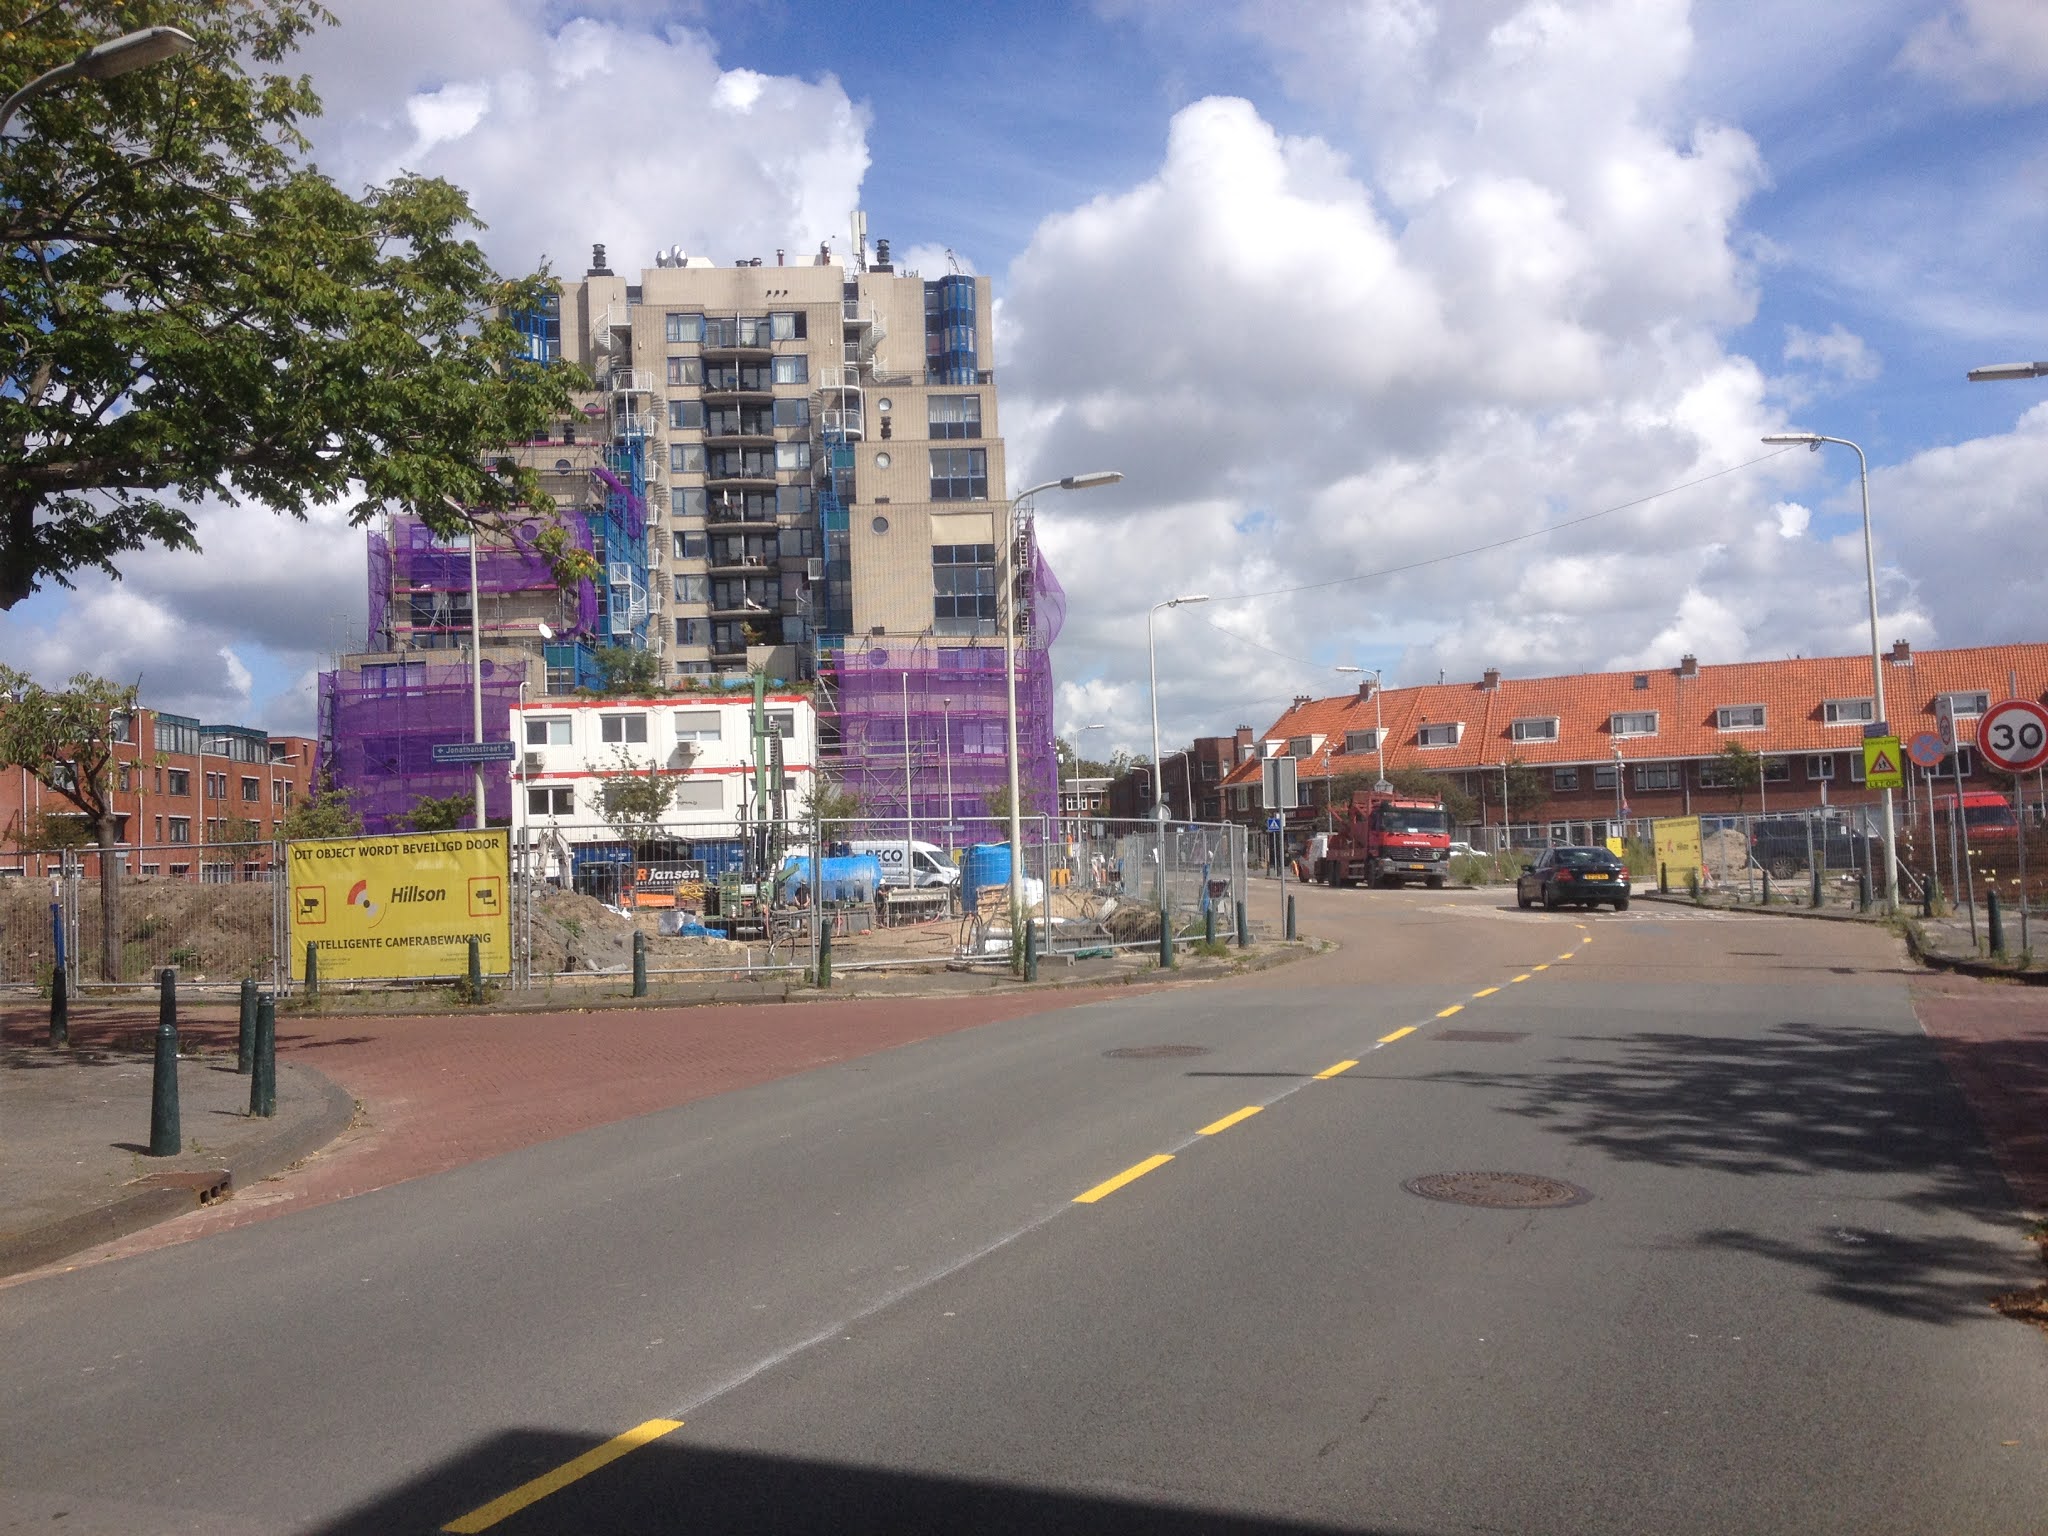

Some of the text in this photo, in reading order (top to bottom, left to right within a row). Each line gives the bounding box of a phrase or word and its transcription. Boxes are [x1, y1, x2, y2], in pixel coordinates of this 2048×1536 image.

[1992, 723, 2043, 751] 30
[445, 745, 501, 754] Jonathanstraat
[294, 838, 500, 860] DIT OBJECT WORDT BEVEILIGD DOOR
[636, 867, 700, 882] R Jansen
[391, 886, 446, 904] Hillson
[307, 932, 491, 950] NTELLIGENTE CAMERABEWAKNG
